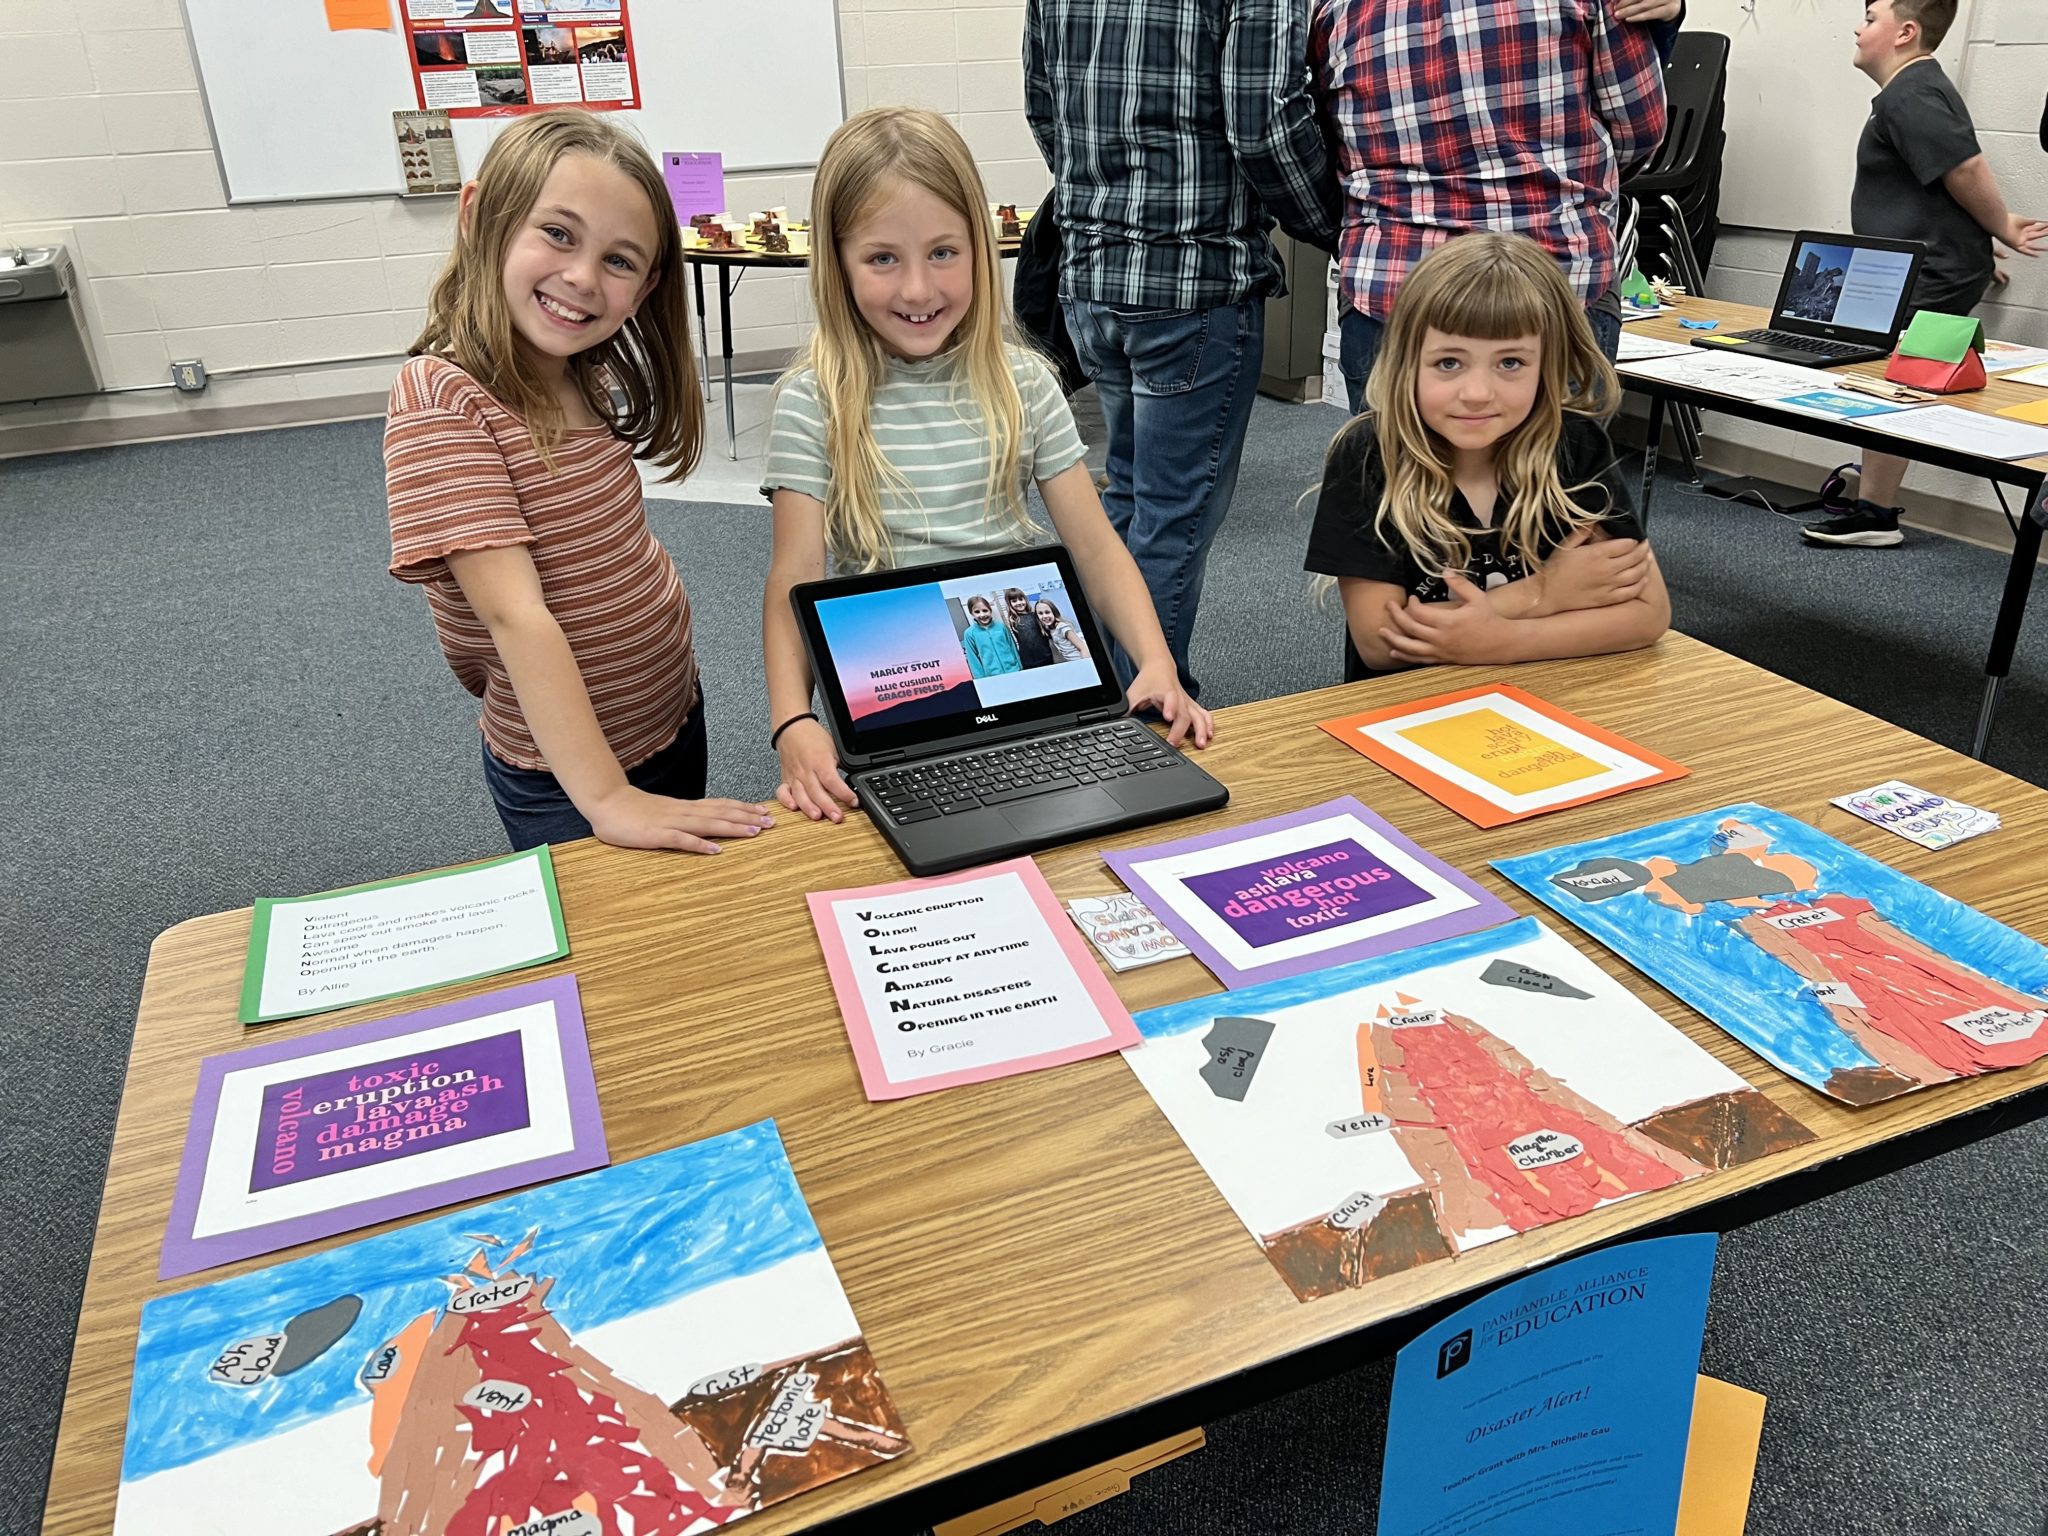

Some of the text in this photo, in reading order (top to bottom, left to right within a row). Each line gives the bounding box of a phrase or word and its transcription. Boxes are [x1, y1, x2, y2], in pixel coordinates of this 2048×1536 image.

[870, 660, 940, 679] MARLEY STOUT
[874, 674, 942, 694] ALLIE CUSHMAN
[877, 682, 946, 702] GRACIE FIELDS
[976, 713, 998, 724] DELL
[1481, 744, 1526, 759] erupt
[1487, 734, 1532, 749] scary
[1498, 752, 1582, 778] dangerous
[1260, 850, 1350, 878] volcano
[1235, 882, 1276, 900] ash
[1263, 868, 1317, 890] lava
[1224, 866, 1392, 919] dangerous
[1317, 892, 1360, 910] hot
[304, 932, 336, 940] Lava
[340, 924, 374, 935] cools
[378, 918, 401, 927] and
[405, 908, 446, 921] makes
[450, 898, 501, 912] volcanic
[304, 914, 379, 932] Outrageous
[305, 912, 348, 922] Violent
[1286, 906, 1348, 930] toxic
[303, 941, 329, 949] Can
[334, 934, 368, 944] spew
[372, 928, 391, 936] out
[396, 918, 438, 932] smoke
[442, 913, 464, 922] and
[1096, 922, 1164, 944] LCANO
[302, 944, 359, 958] Awsome
[302, 954, 349, 968] Normal
[354, 946, 388, 958] when
[392, 934, 452, 950] damages
[1141, 936, 1178, 952] OW
[300, 962, 356, 976] Opening
[362, 958, 372, 966] in
[378, 954, 398, 963] the
[320, 982, 350, 992] Allie
[907, 1038, 974, 1059] By Gracie
[347, 1060, 440, 1092] toxic
[312, 1068, 476, 1116] eruption
[438, 1074, 504, 1103] ash
[316, 1098, 468, 1144] damage
[354, 1094, 436, 1124] lava
[272, 1086, 312, 1176] volcano
[318, 1116, 467, 1162] magma
[1481, 1266, 1649, 1334] PANHANDLE ALLIANCE
[1478, 1283, 1646, 1349] for EDUCATION
[1466, 1385, 1591, 1444] Disaster Alert!
[1443, 1426, 1610, 1493] Teacher Grant with Mrs. Nichelle Gau
